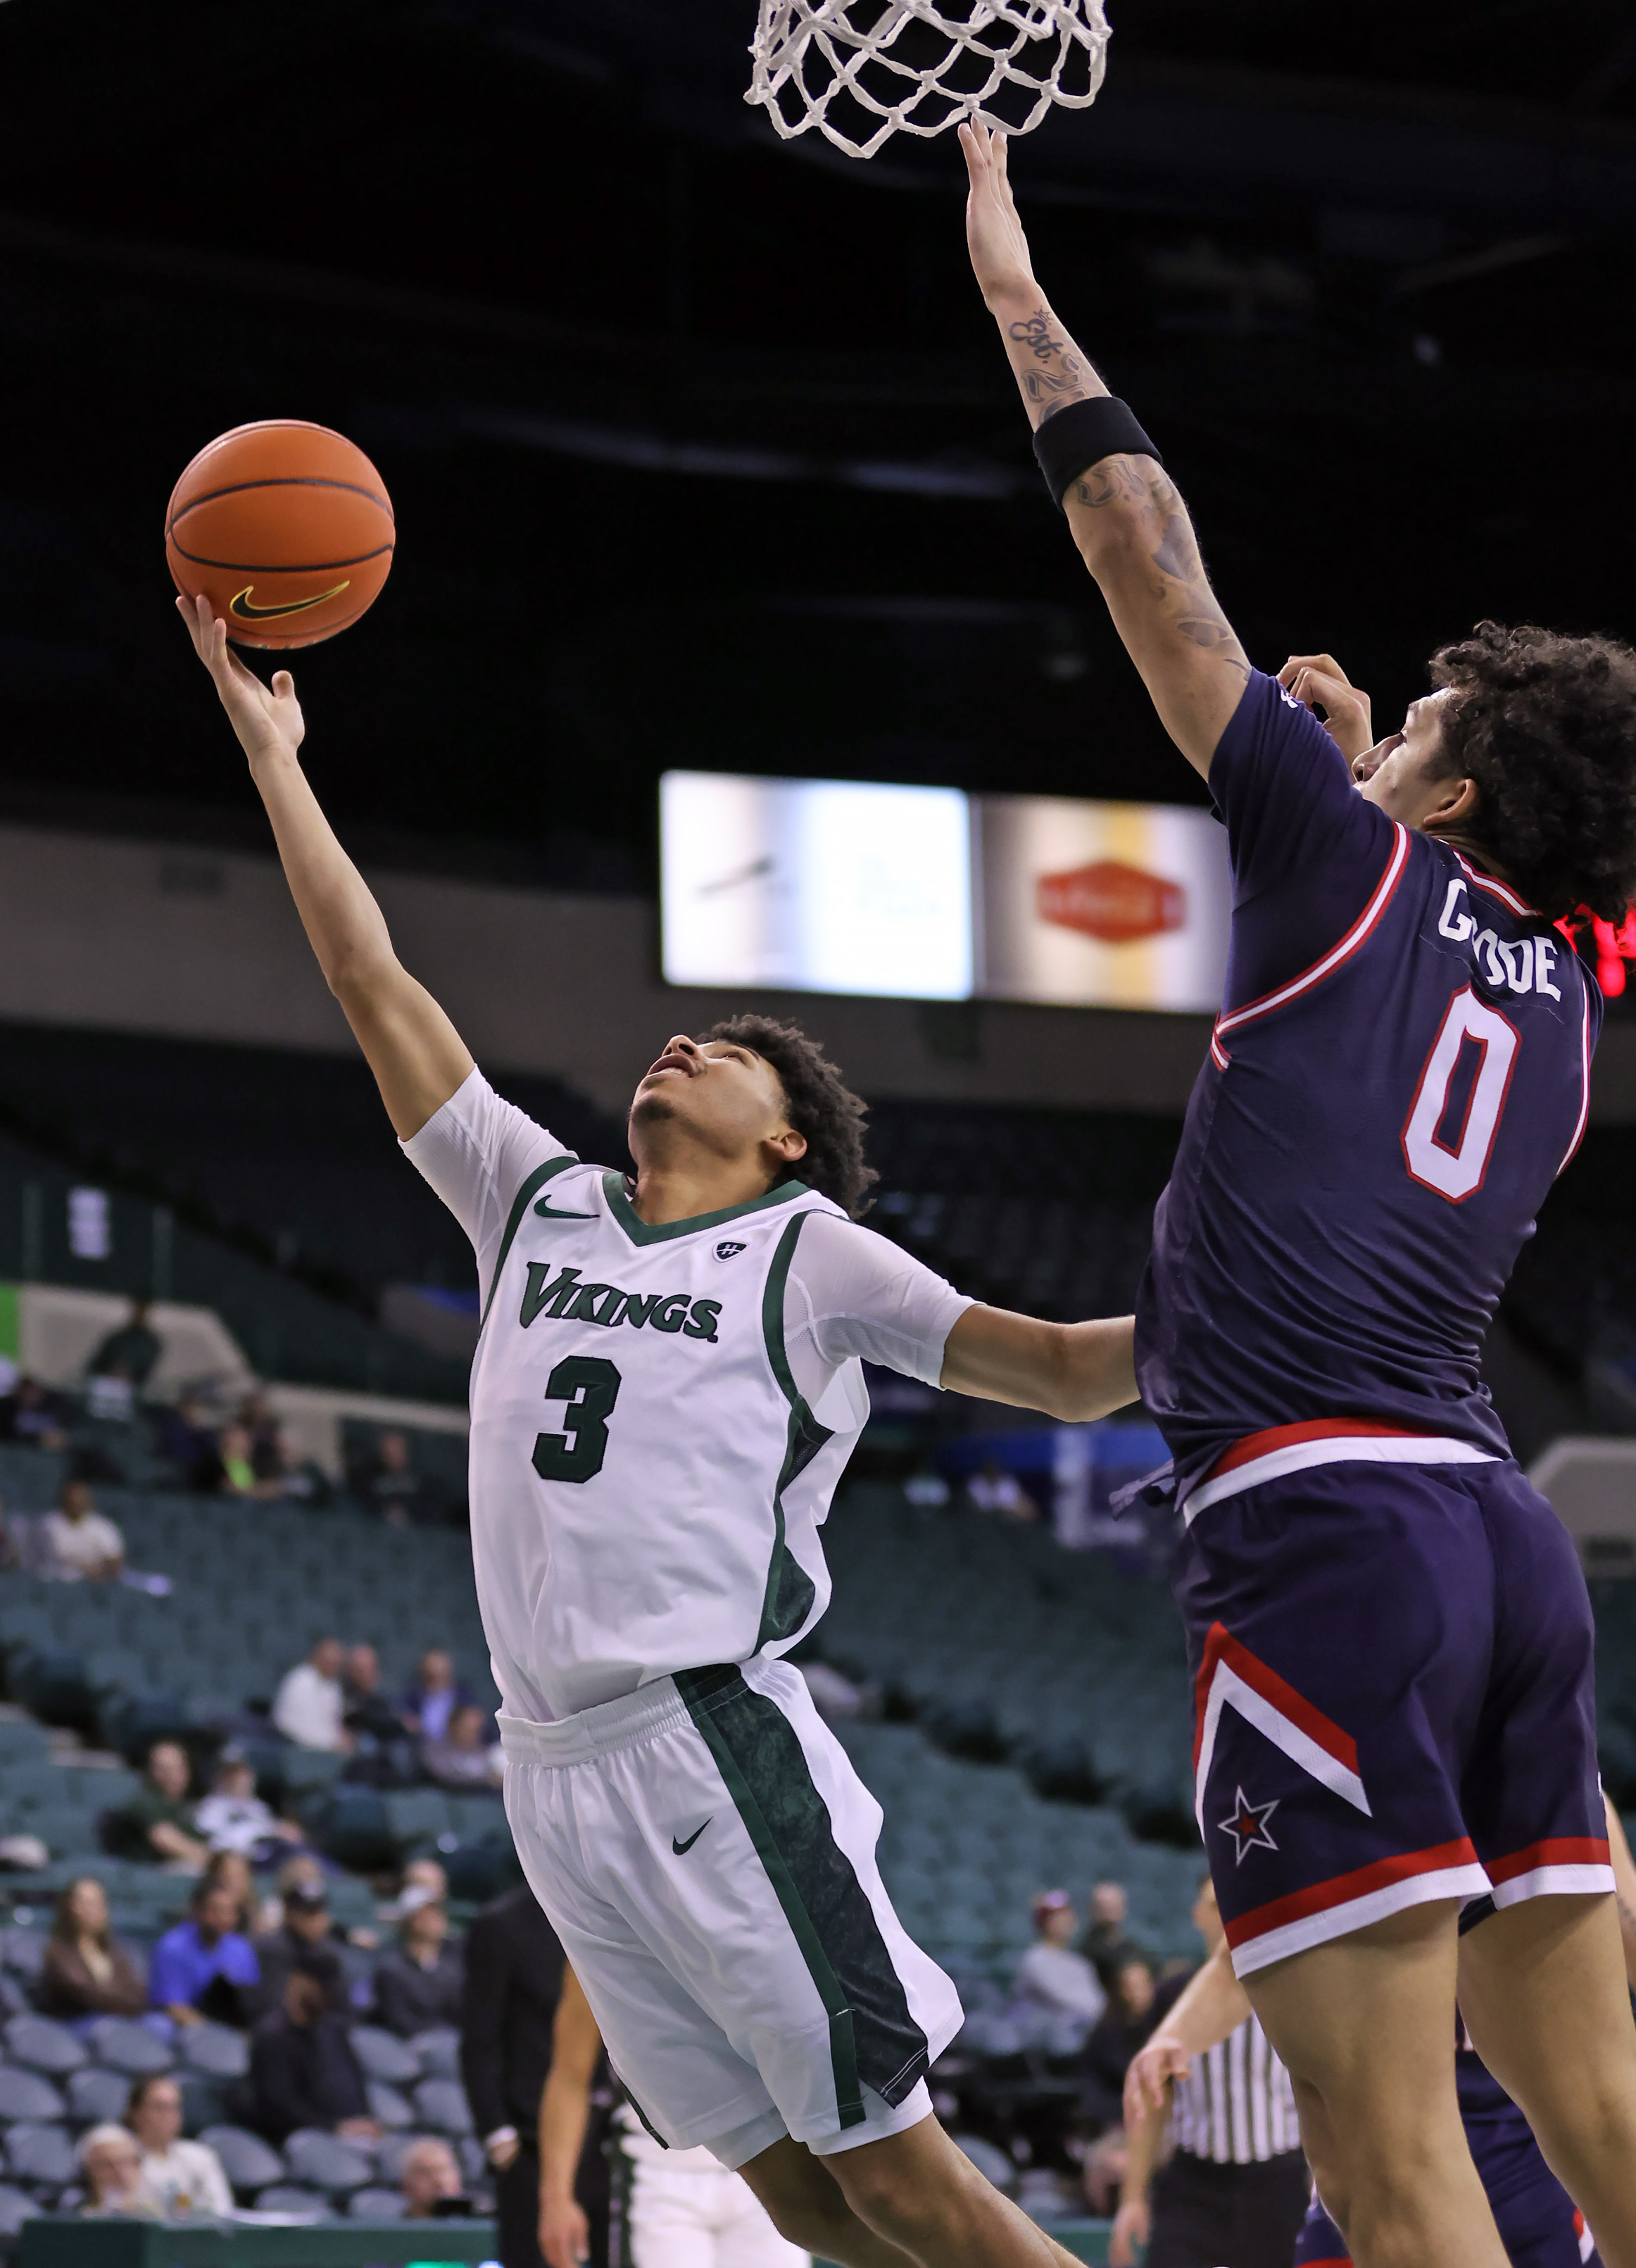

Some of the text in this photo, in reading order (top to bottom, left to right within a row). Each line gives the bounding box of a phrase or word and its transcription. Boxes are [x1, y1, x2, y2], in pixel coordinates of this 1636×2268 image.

[1400, 980, 1522, 1205] 0
[520, 1261, 723, 1343] VIKINGS
[531, 1355, 622, 1484] 3
